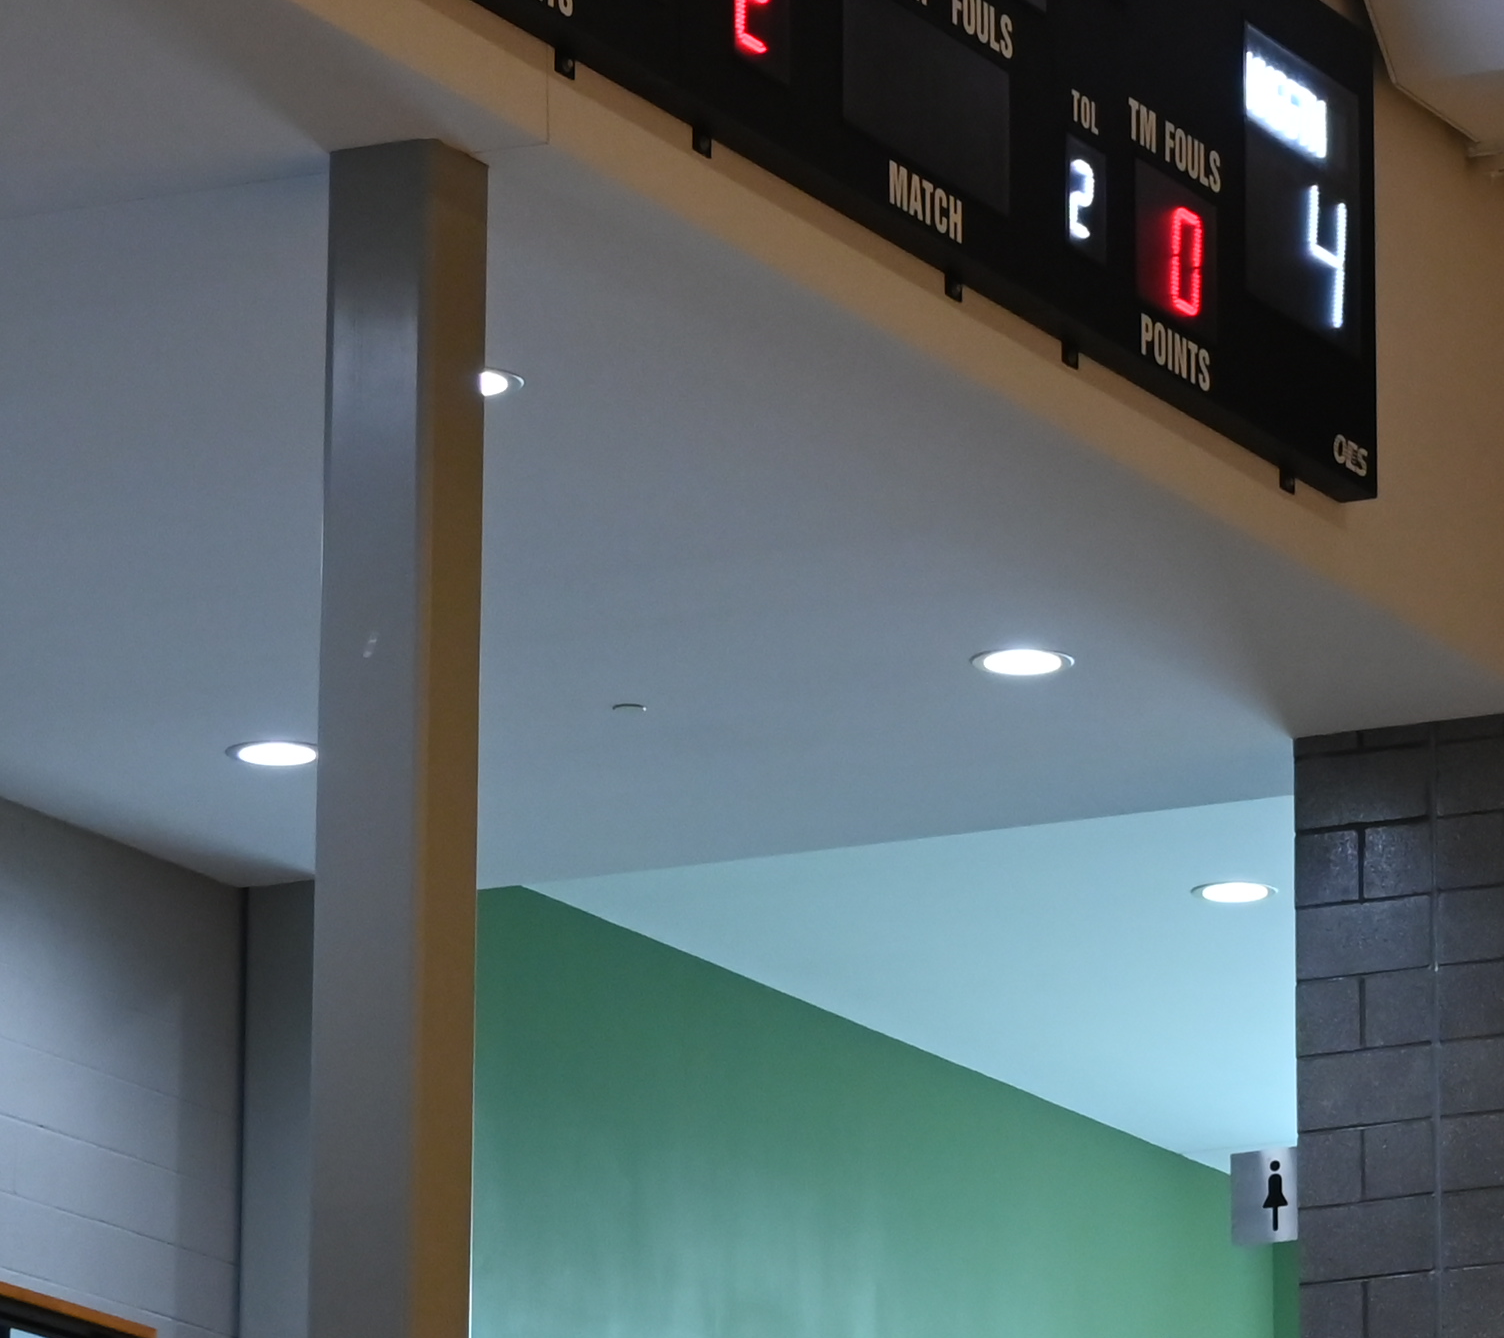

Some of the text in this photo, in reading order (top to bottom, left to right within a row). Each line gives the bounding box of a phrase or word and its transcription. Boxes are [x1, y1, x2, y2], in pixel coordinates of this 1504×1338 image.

[1071, 89, 1100, 137] TOL
[1128, 96, 1222, 196] TM FOULS
[888, 159, 965, 247] MATCH
[1067, 159, 1096, 241] 2
[1170, 204, 1203, 319] 0
[1309, 184, 1347, 329] 4
[1140, 311, 1213, 393] POINTS
[1333, 434, 1368, 478] OES
